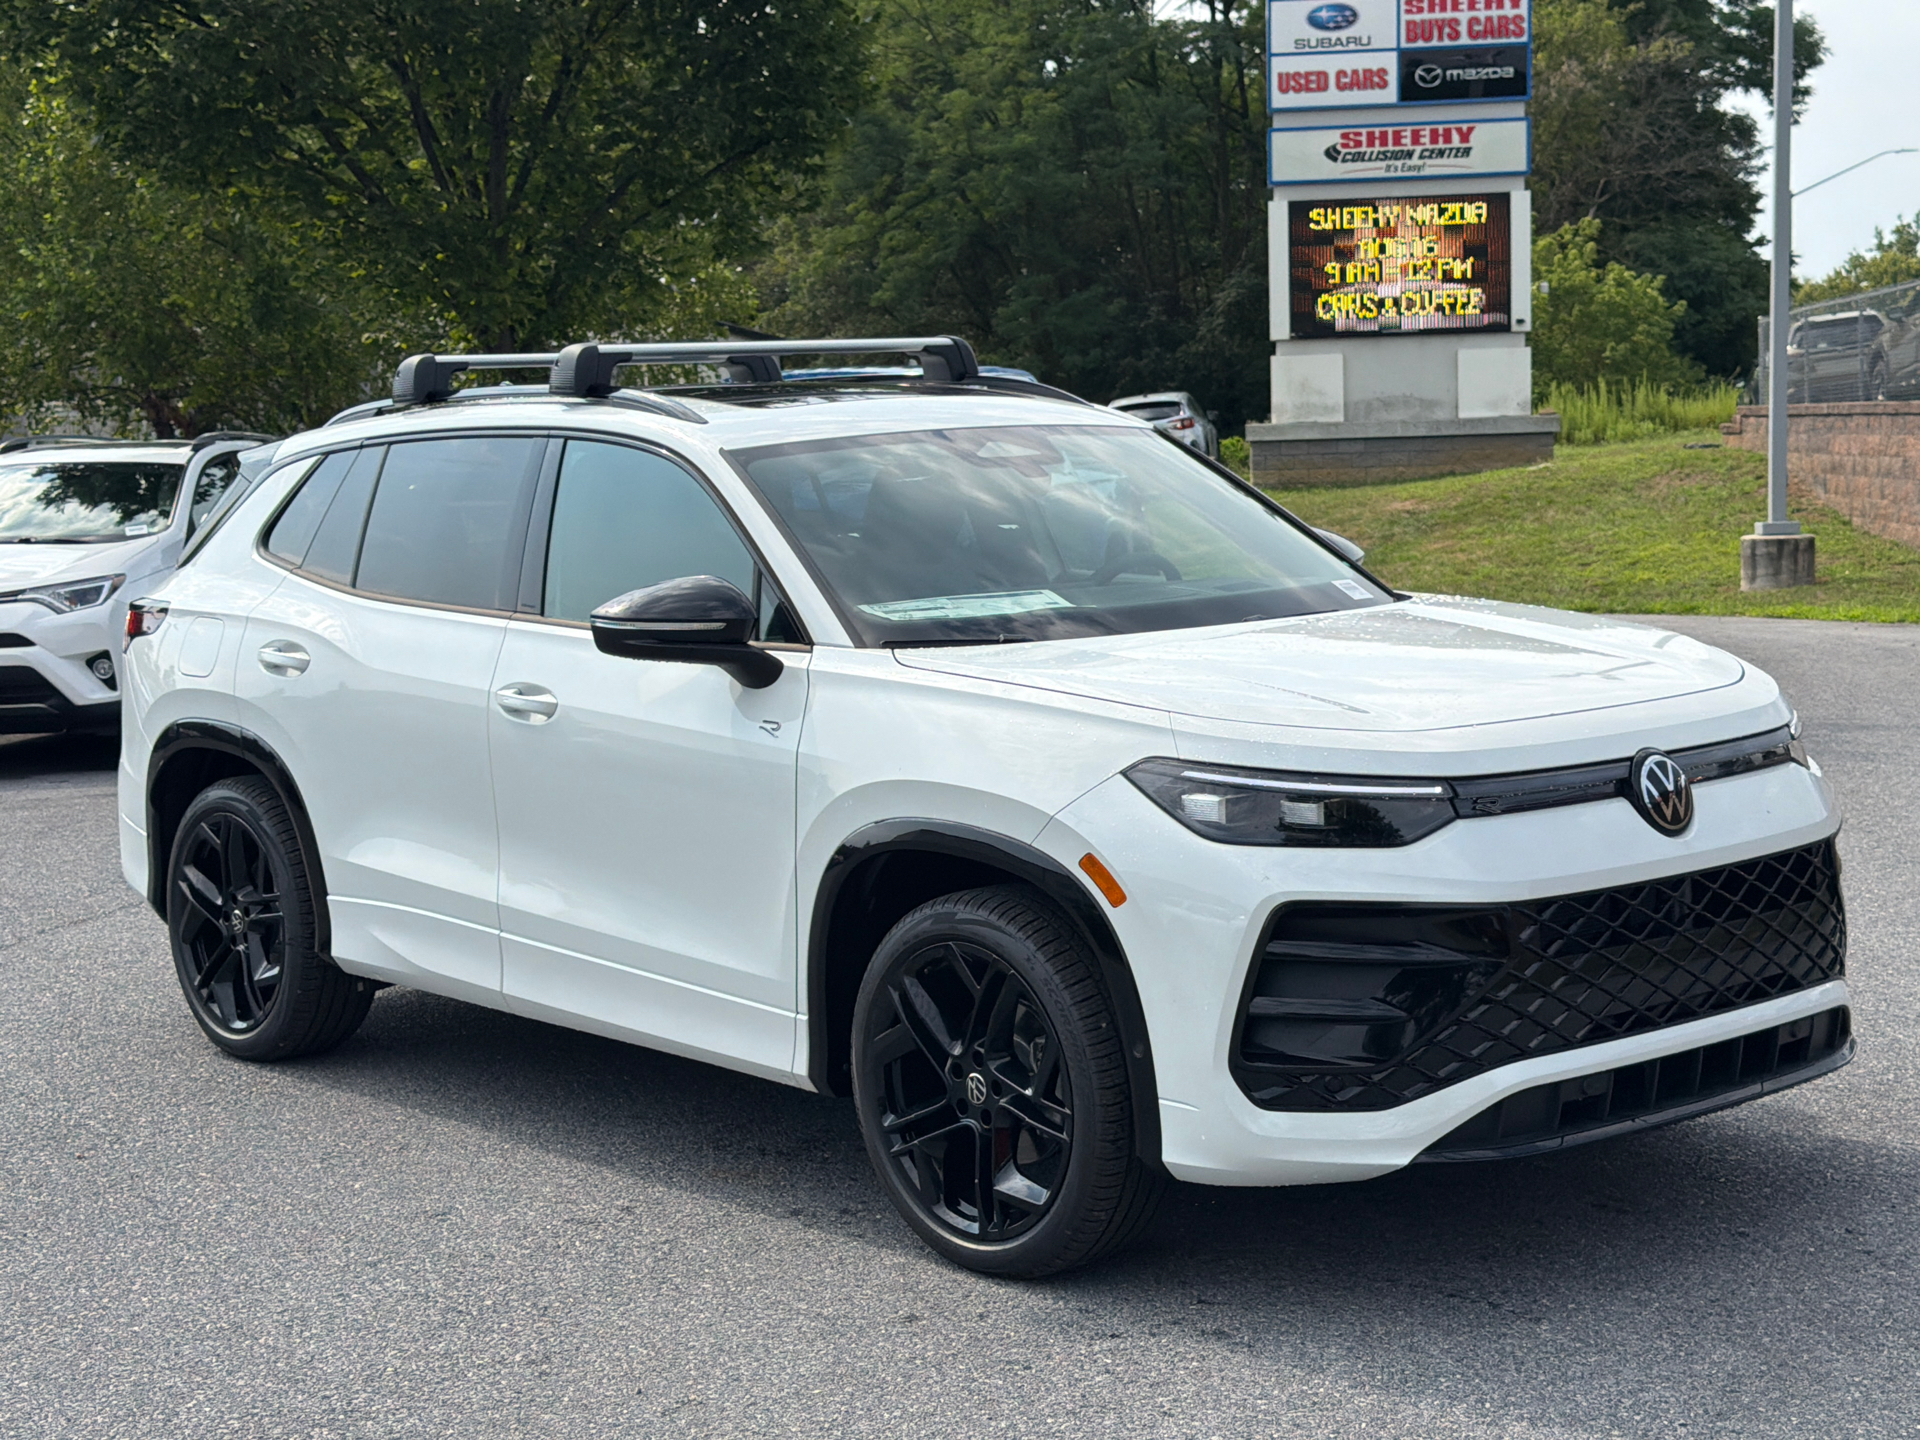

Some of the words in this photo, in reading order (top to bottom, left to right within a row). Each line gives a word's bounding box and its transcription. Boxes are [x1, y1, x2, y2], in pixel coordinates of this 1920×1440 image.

[1405, 17, 1461, 44] BUYS
[1467, 14, 1525, 41] CARS
[1294, 35, 1371, 50] SUBARU
[1277, 70, 1329, 94] USED
[1335, 67, 1388, 91] CARS
[1340, 126, 1476, 149] SHEEHY
[1341, 149, 1416, 163] COLLISION
[1418, 146, 1473, 160] CENTER
[1309, 205, 1400, 230] SHEEHY
